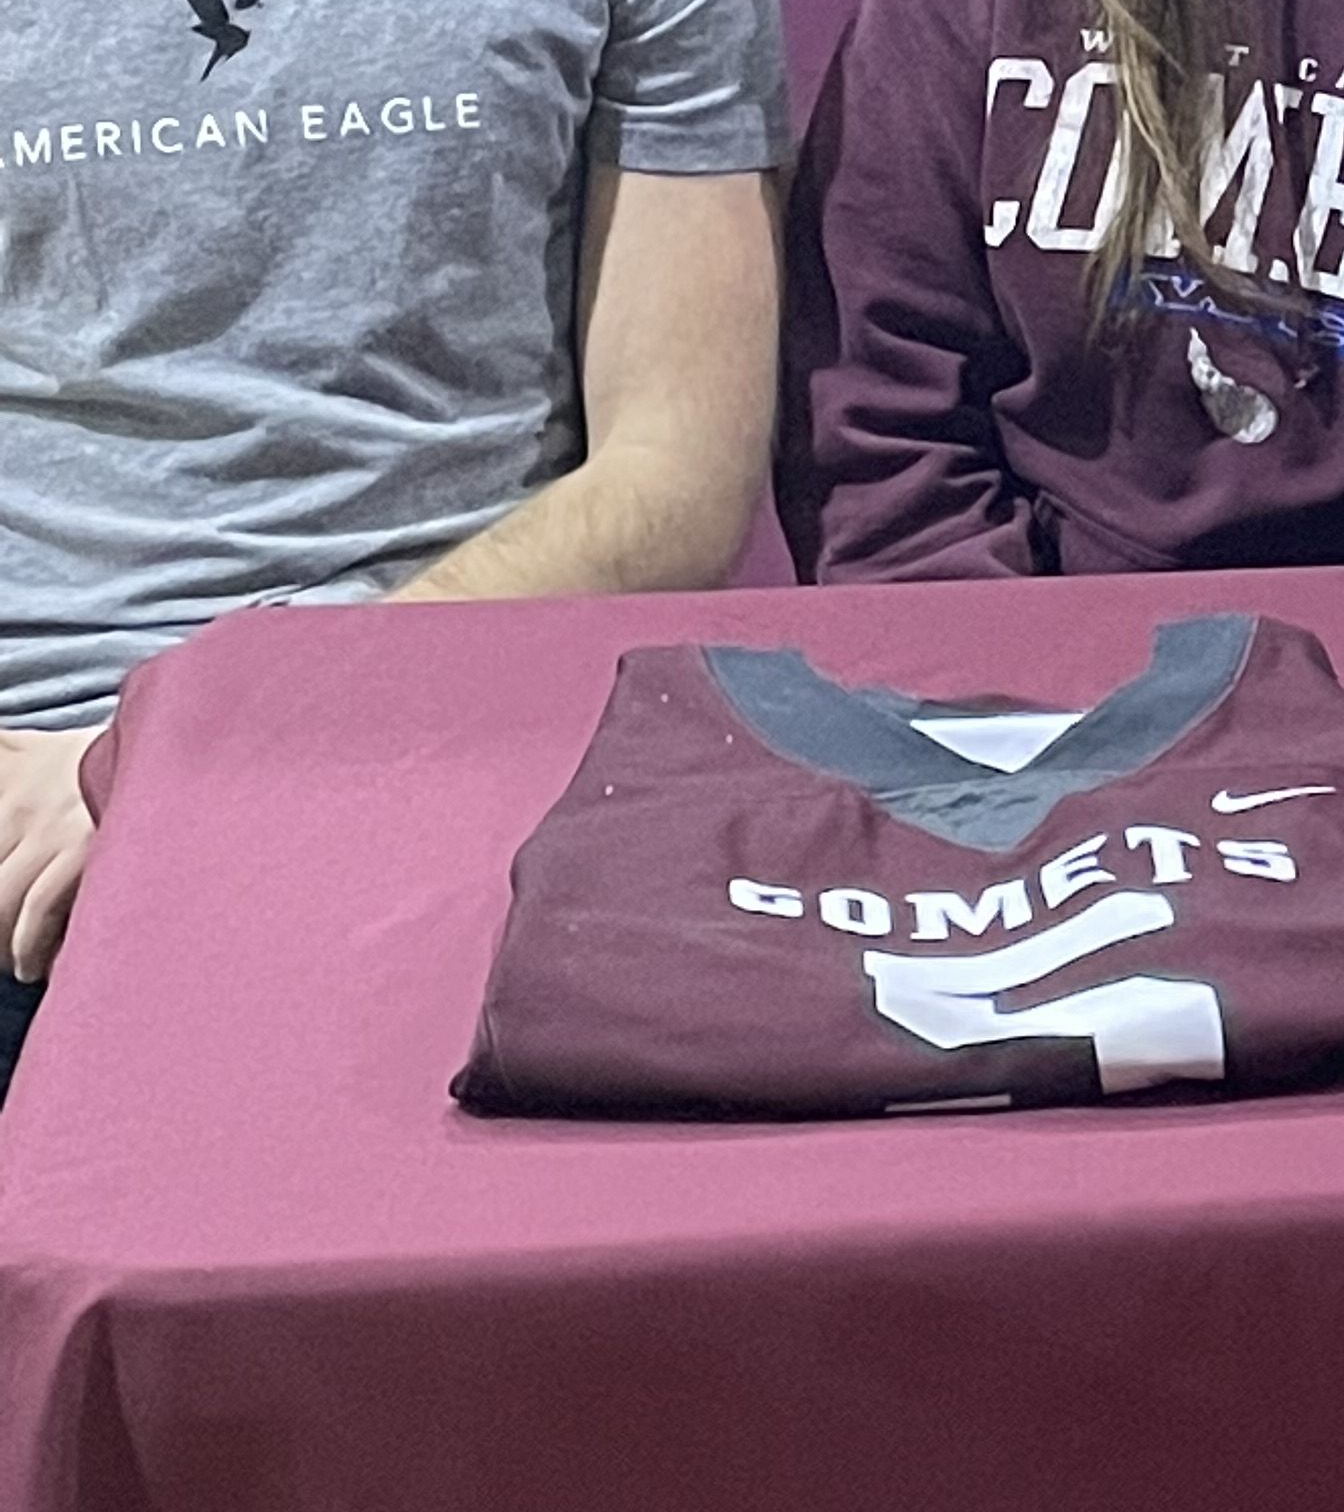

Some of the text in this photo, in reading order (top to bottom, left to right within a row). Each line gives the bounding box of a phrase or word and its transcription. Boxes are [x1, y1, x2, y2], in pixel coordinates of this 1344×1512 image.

[0, 92, 481, 169] MERICAN EAGLE
[728, 824, 1299, 941] COMETS
